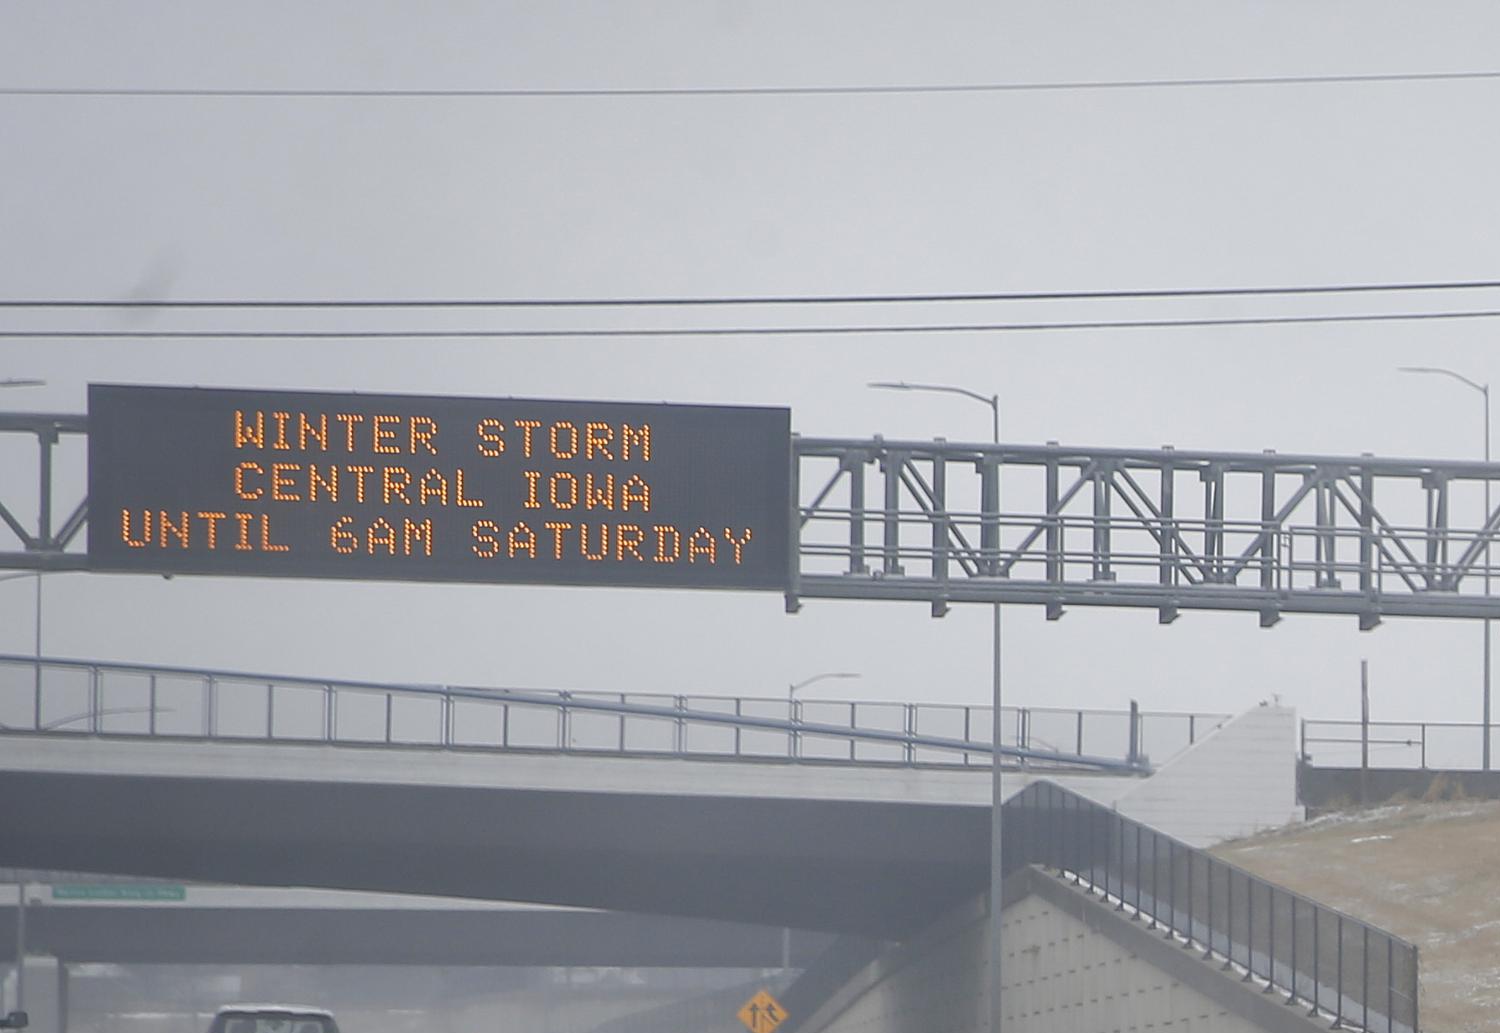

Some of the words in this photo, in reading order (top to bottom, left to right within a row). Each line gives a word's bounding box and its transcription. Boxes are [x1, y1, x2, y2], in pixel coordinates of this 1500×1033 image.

[233, 410, 438, 454] WINTER
[476, 418, 652, 461] STORM
[233, 461, 484, 507] CENTRAL
[523, 470, 652, 512] IOWA
[121, 510, 289, 552] UNTIL
[330, 516, 433, 556] 6AM
[471, 519, 753, 563] SATURDAY
